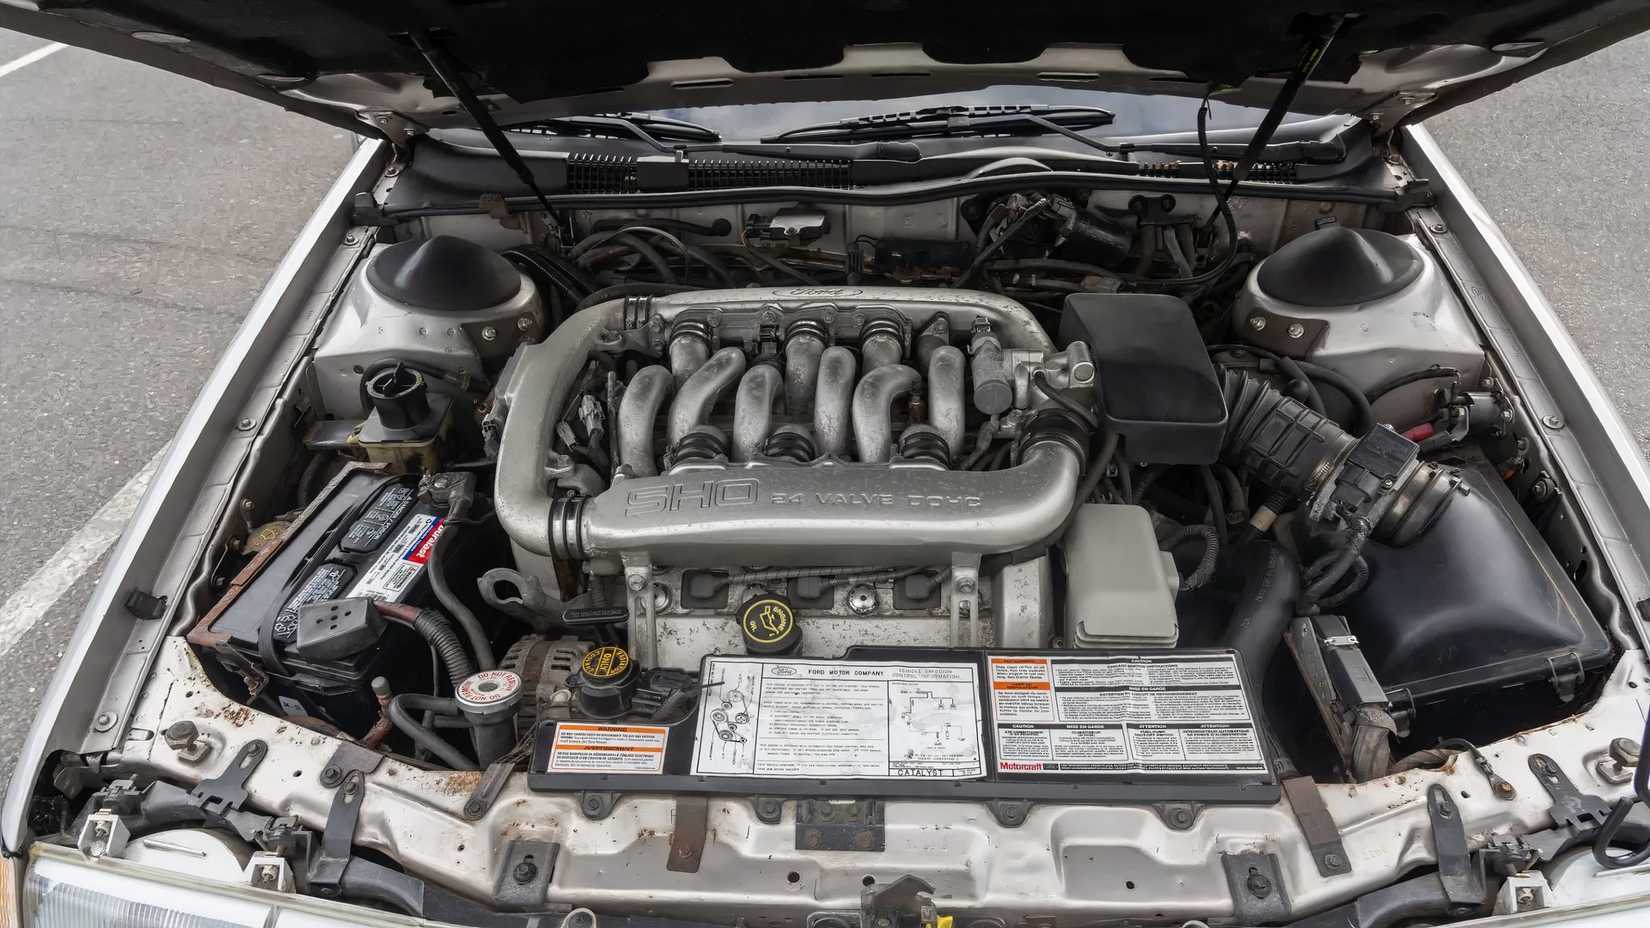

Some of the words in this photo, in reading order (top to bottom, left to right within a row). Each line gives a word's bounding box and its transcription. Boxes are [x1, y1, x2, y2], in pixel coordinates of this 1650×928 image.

[625, 478, 760, 517] SHO
[771, 492, 803, 504] 24
[815, 492, 895, 505] VALVE
[907, 494, 982, 507] DOHC
[1000, 762, 1042, 771] Motorcraft
[898, 768, 943, 777] CATALYST
